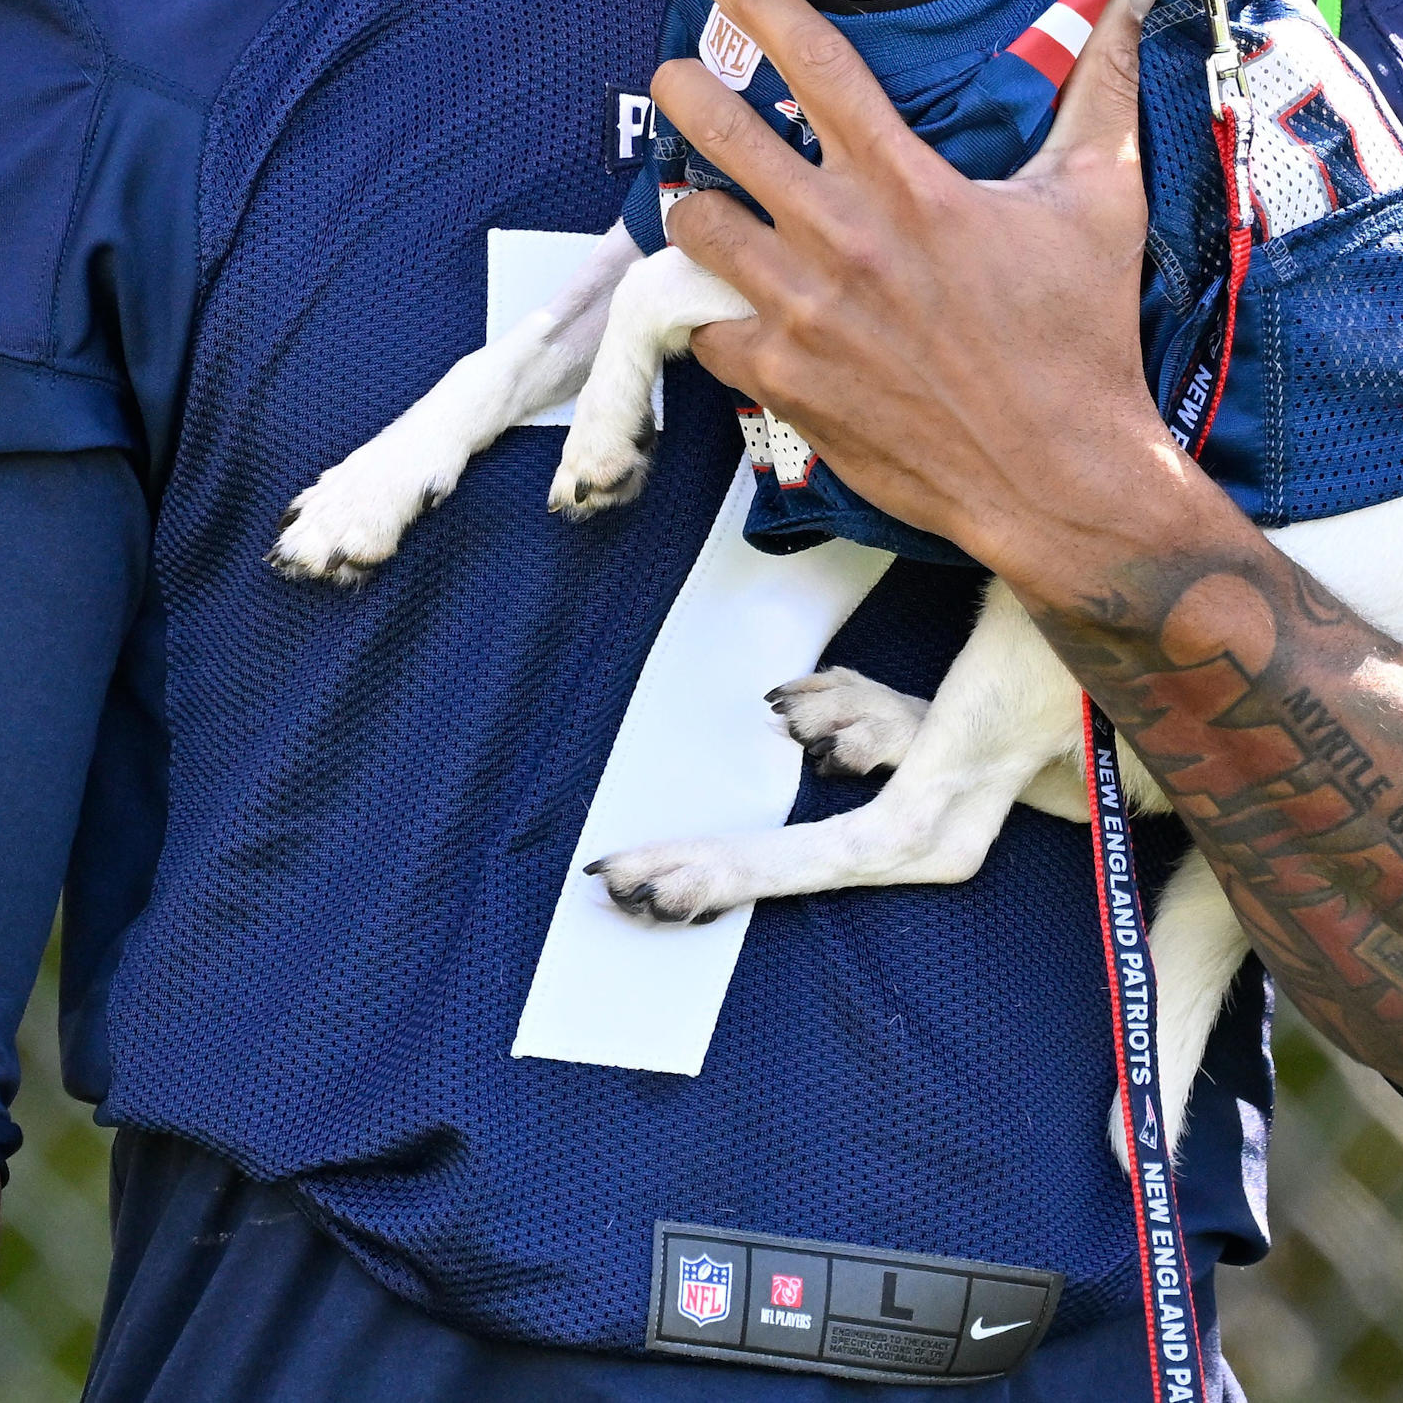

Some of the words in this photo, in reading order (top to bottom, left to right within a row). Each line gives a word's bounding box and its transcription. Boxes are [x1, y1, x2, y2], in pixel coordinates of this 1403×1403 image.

[710, 17, 751, 73] NFL
[1177, 364, 1212, 430] NEW
[1097, 749, 1120, 809] NEW
[1282, 686, 1394, 814] MYRTLE
[1105, 815, 1137, 947] ENGLAND
[1120, 953, 1152, 1086] PATRIOTS
[1143, 1162, 1171, 1224] NEW
[685, 1283, 721, 1315] NFL
[760, 1308, 776, 1325] NFL
[775, 1310, 812, 1330] PLAYERS
[880, 1271, 914, 1321] L
[1151, 1229, 1189, 1362] ENGLAND
[1166, 1368, 1194, 1403] PA
